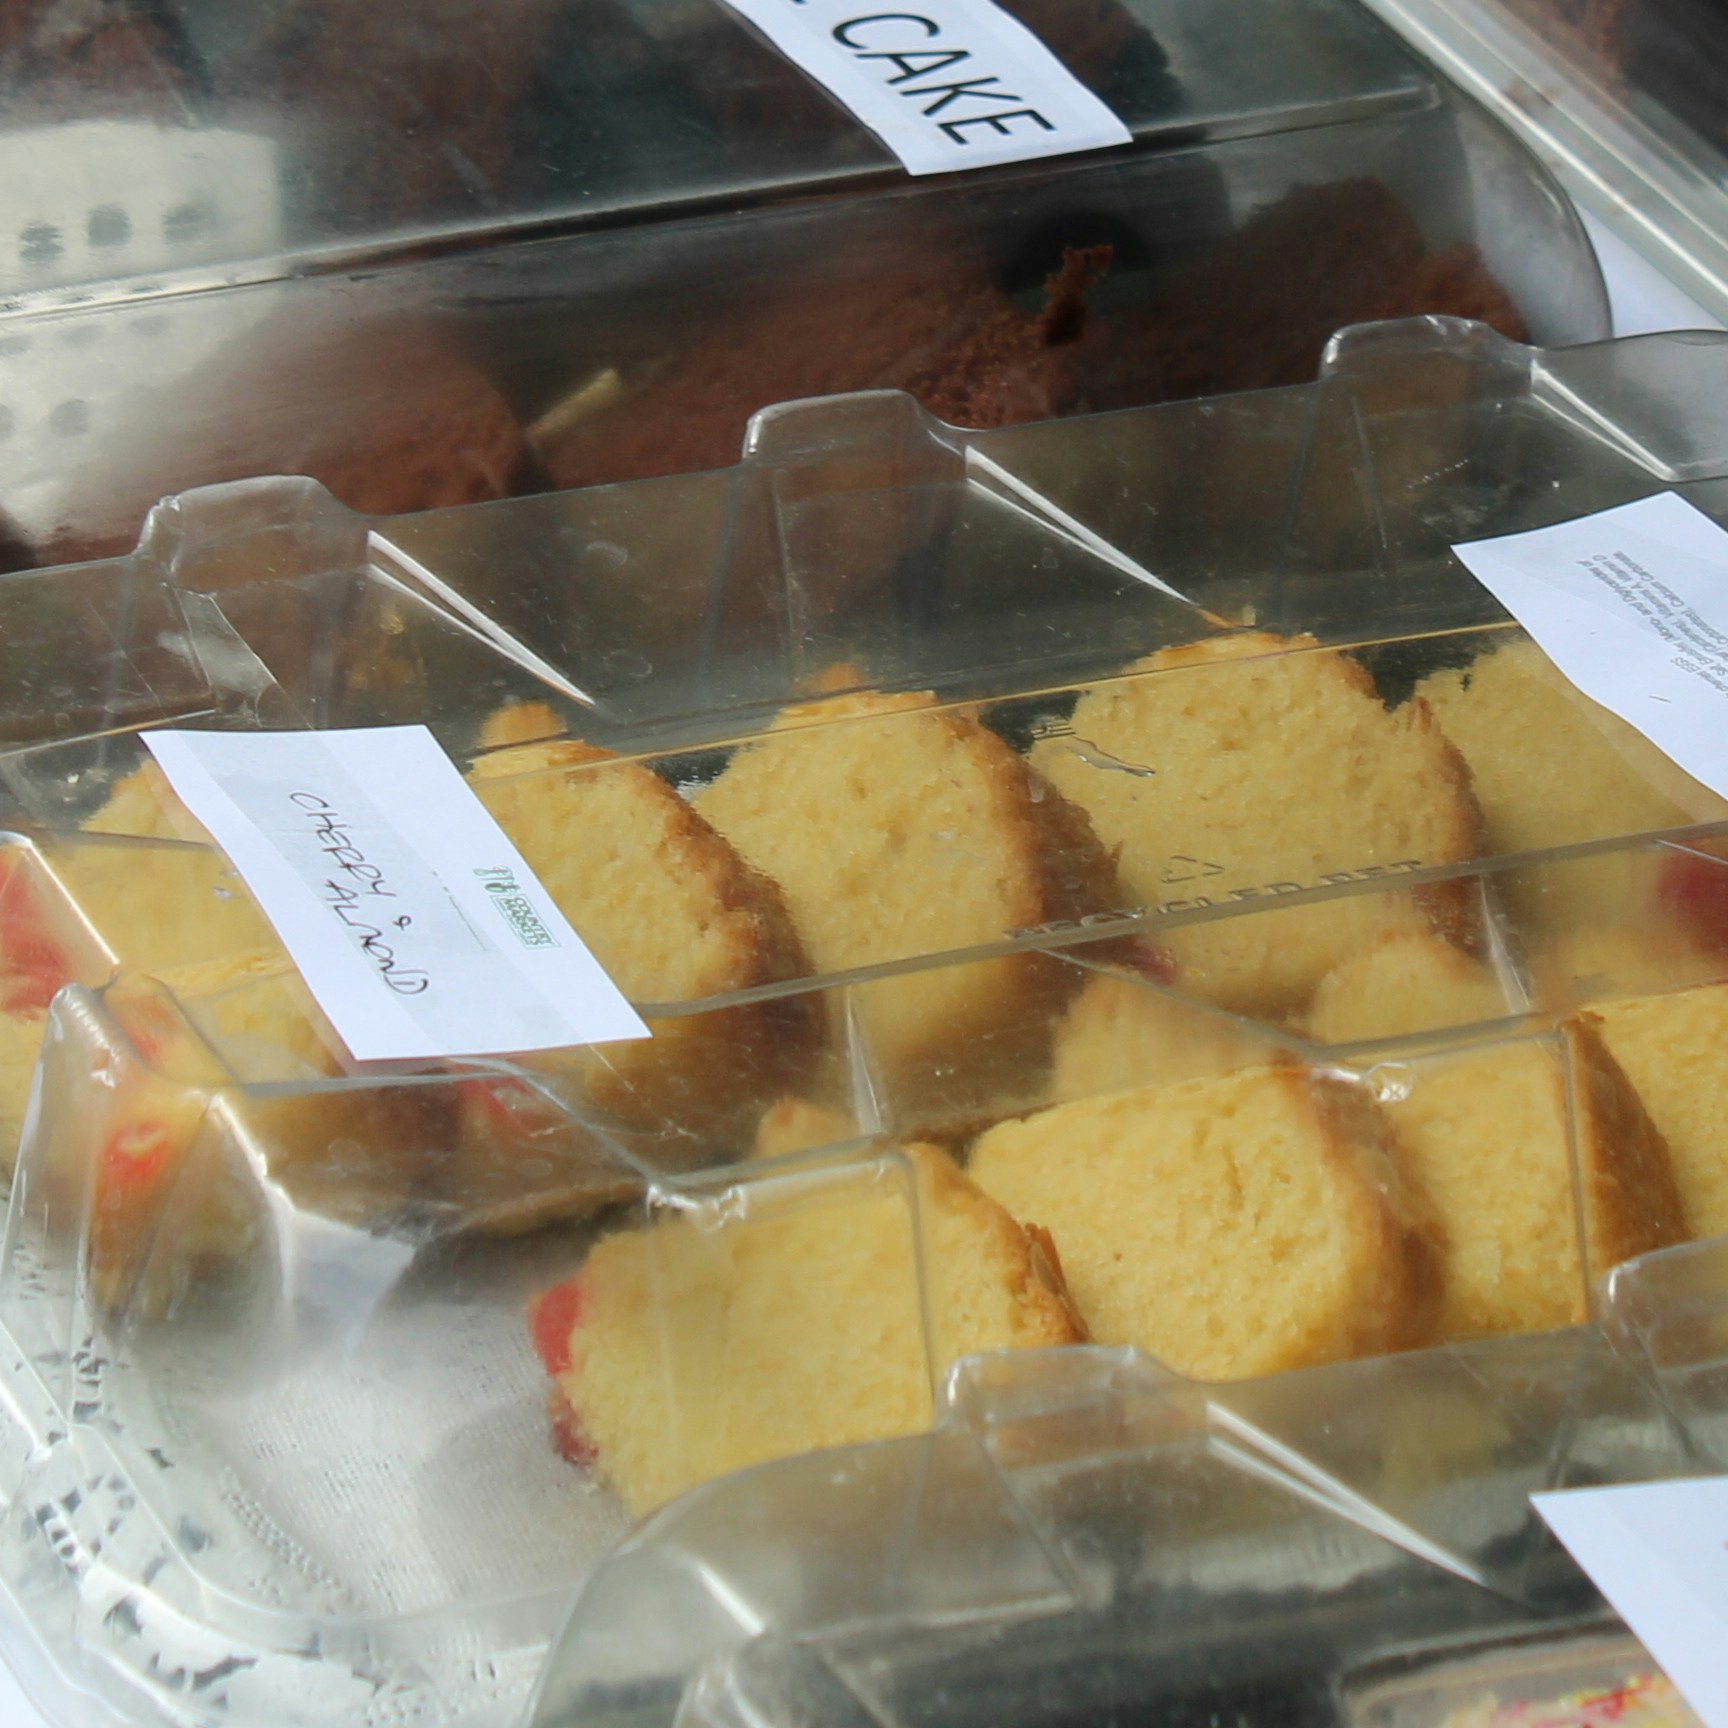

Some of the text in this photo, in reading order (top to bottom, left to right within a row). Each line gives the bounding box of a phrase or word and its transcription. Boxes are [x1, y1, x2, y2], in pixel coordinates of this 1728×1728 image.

[831, 12, 1057, 146] CAKE
[289, 792, 397, 897] CHERRY
[324, 879, 429, 995] ALMOND
